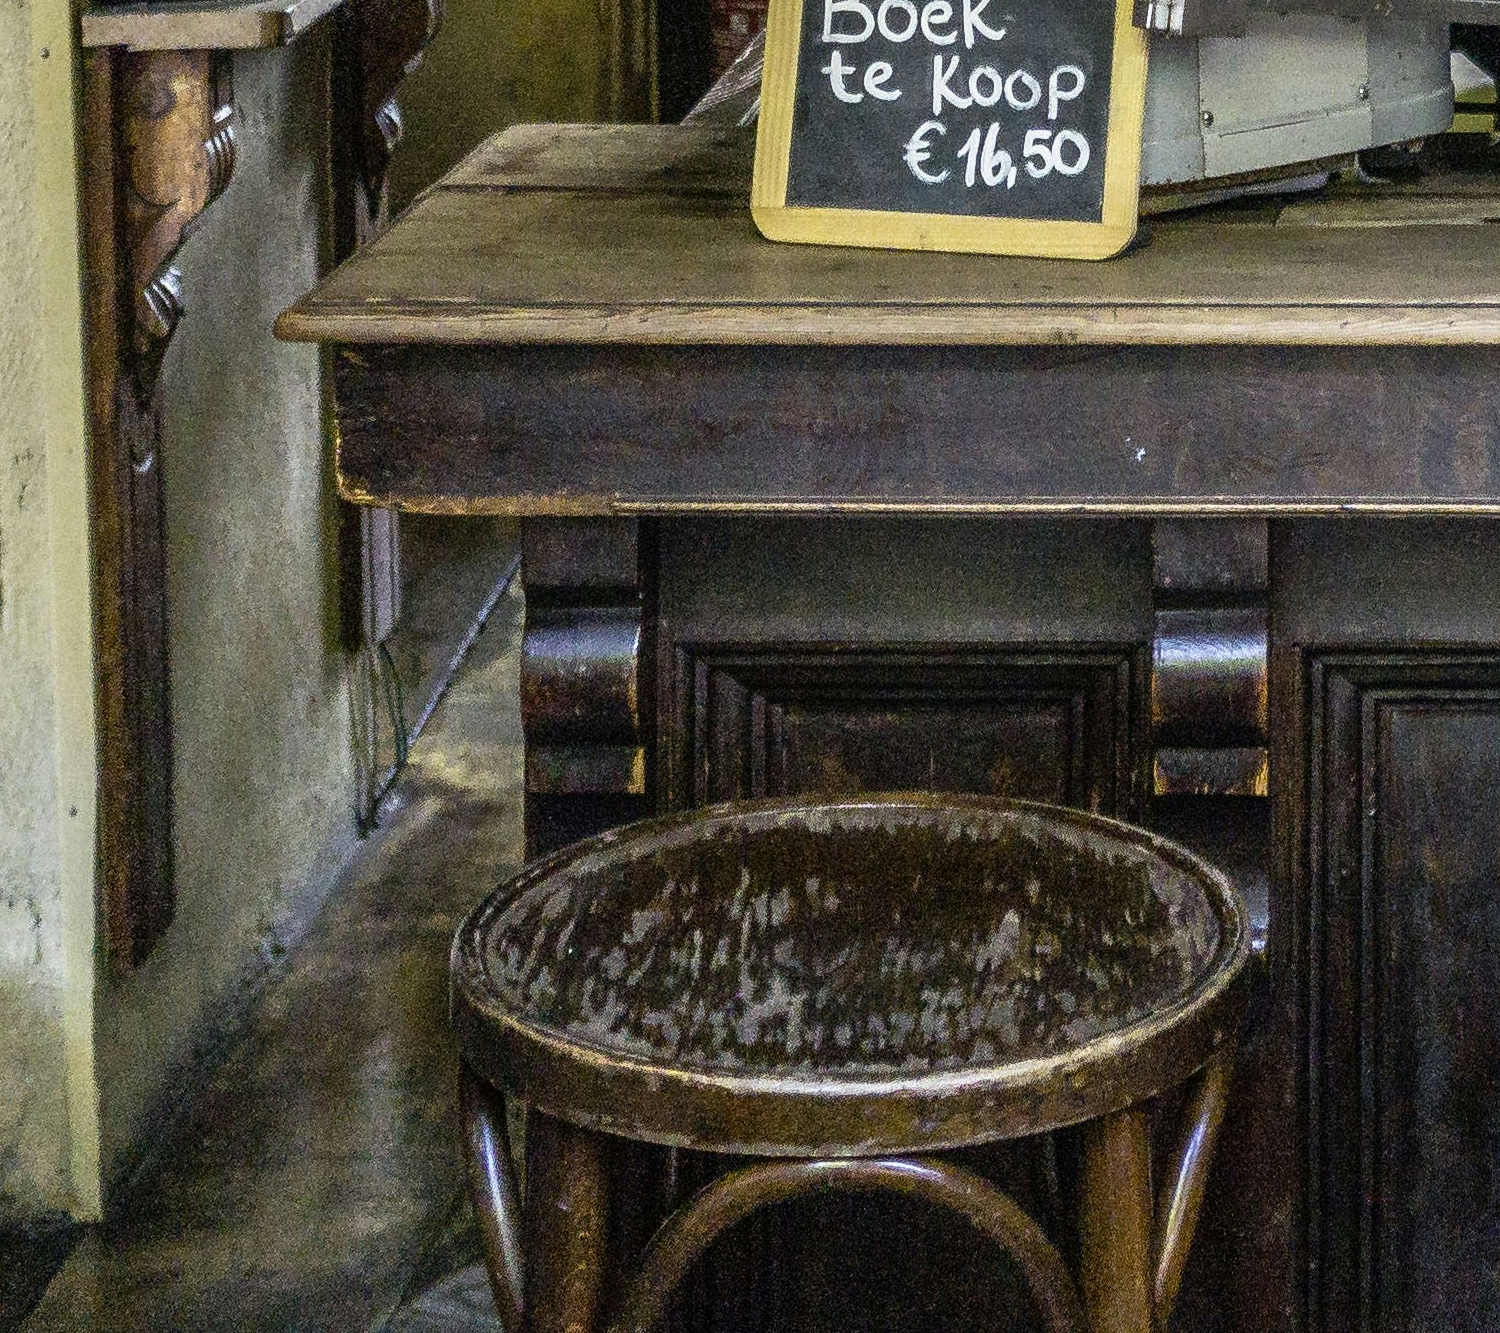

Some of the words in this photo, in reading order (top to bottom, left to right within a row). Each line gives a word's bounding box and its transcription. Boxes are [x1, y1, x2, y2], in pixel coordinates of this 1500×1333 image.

[821, 50, 902, 103] te
[903, 120, 950, 183] €
[957, 122, 1090, 189] 16,50
